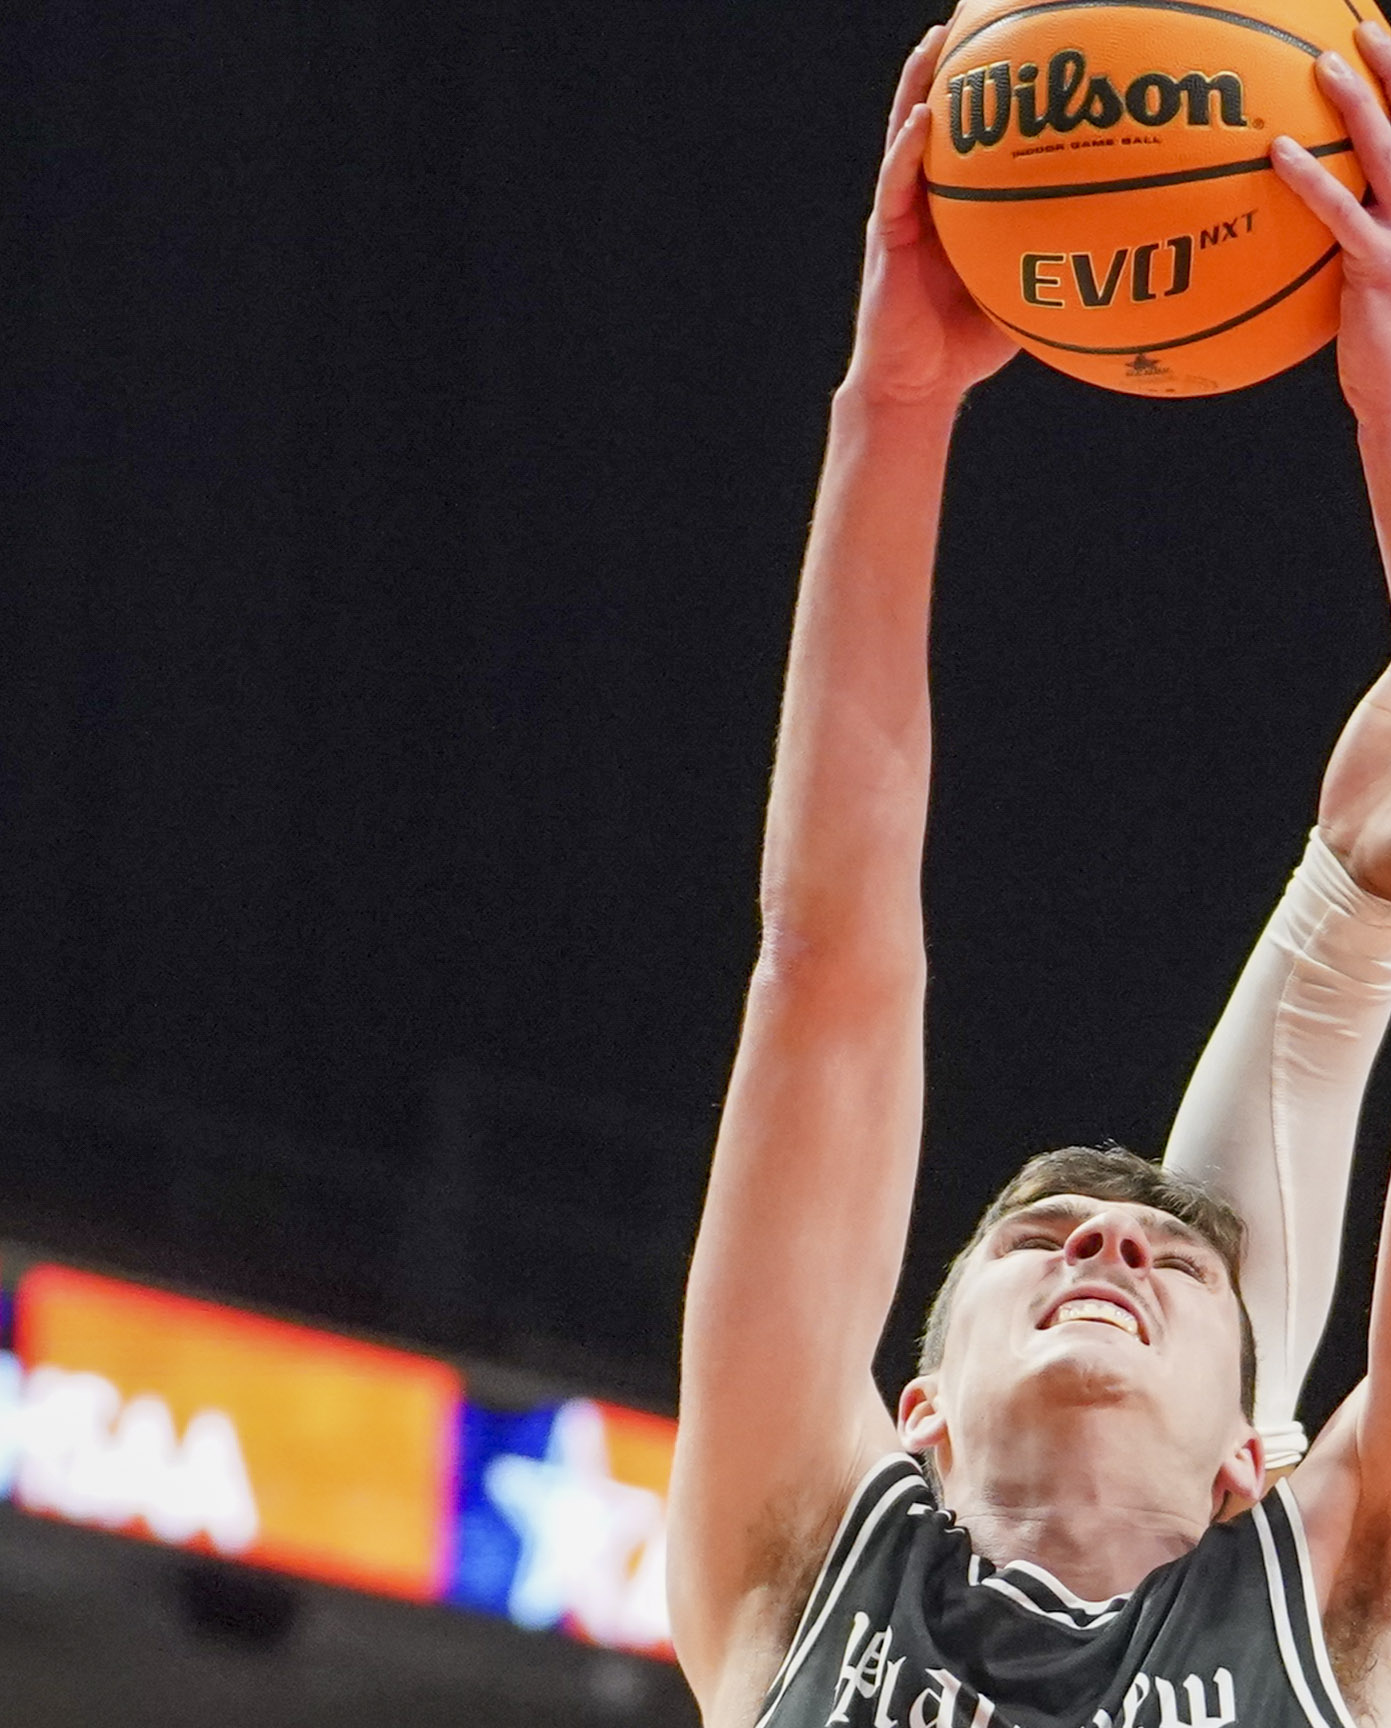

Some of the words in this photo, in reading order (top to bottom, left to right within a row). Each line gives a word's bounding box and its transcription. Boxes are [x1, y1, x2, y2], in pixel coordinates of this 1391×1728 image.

[949, 48, 1249, 155] Wilson
[1070, 138, 1115, 149] GAME
[1121, 136, 1162, 145] BALL
[1021, 235, 1193, 309] EVO
[1200, 208, 1259, 250] NXT
